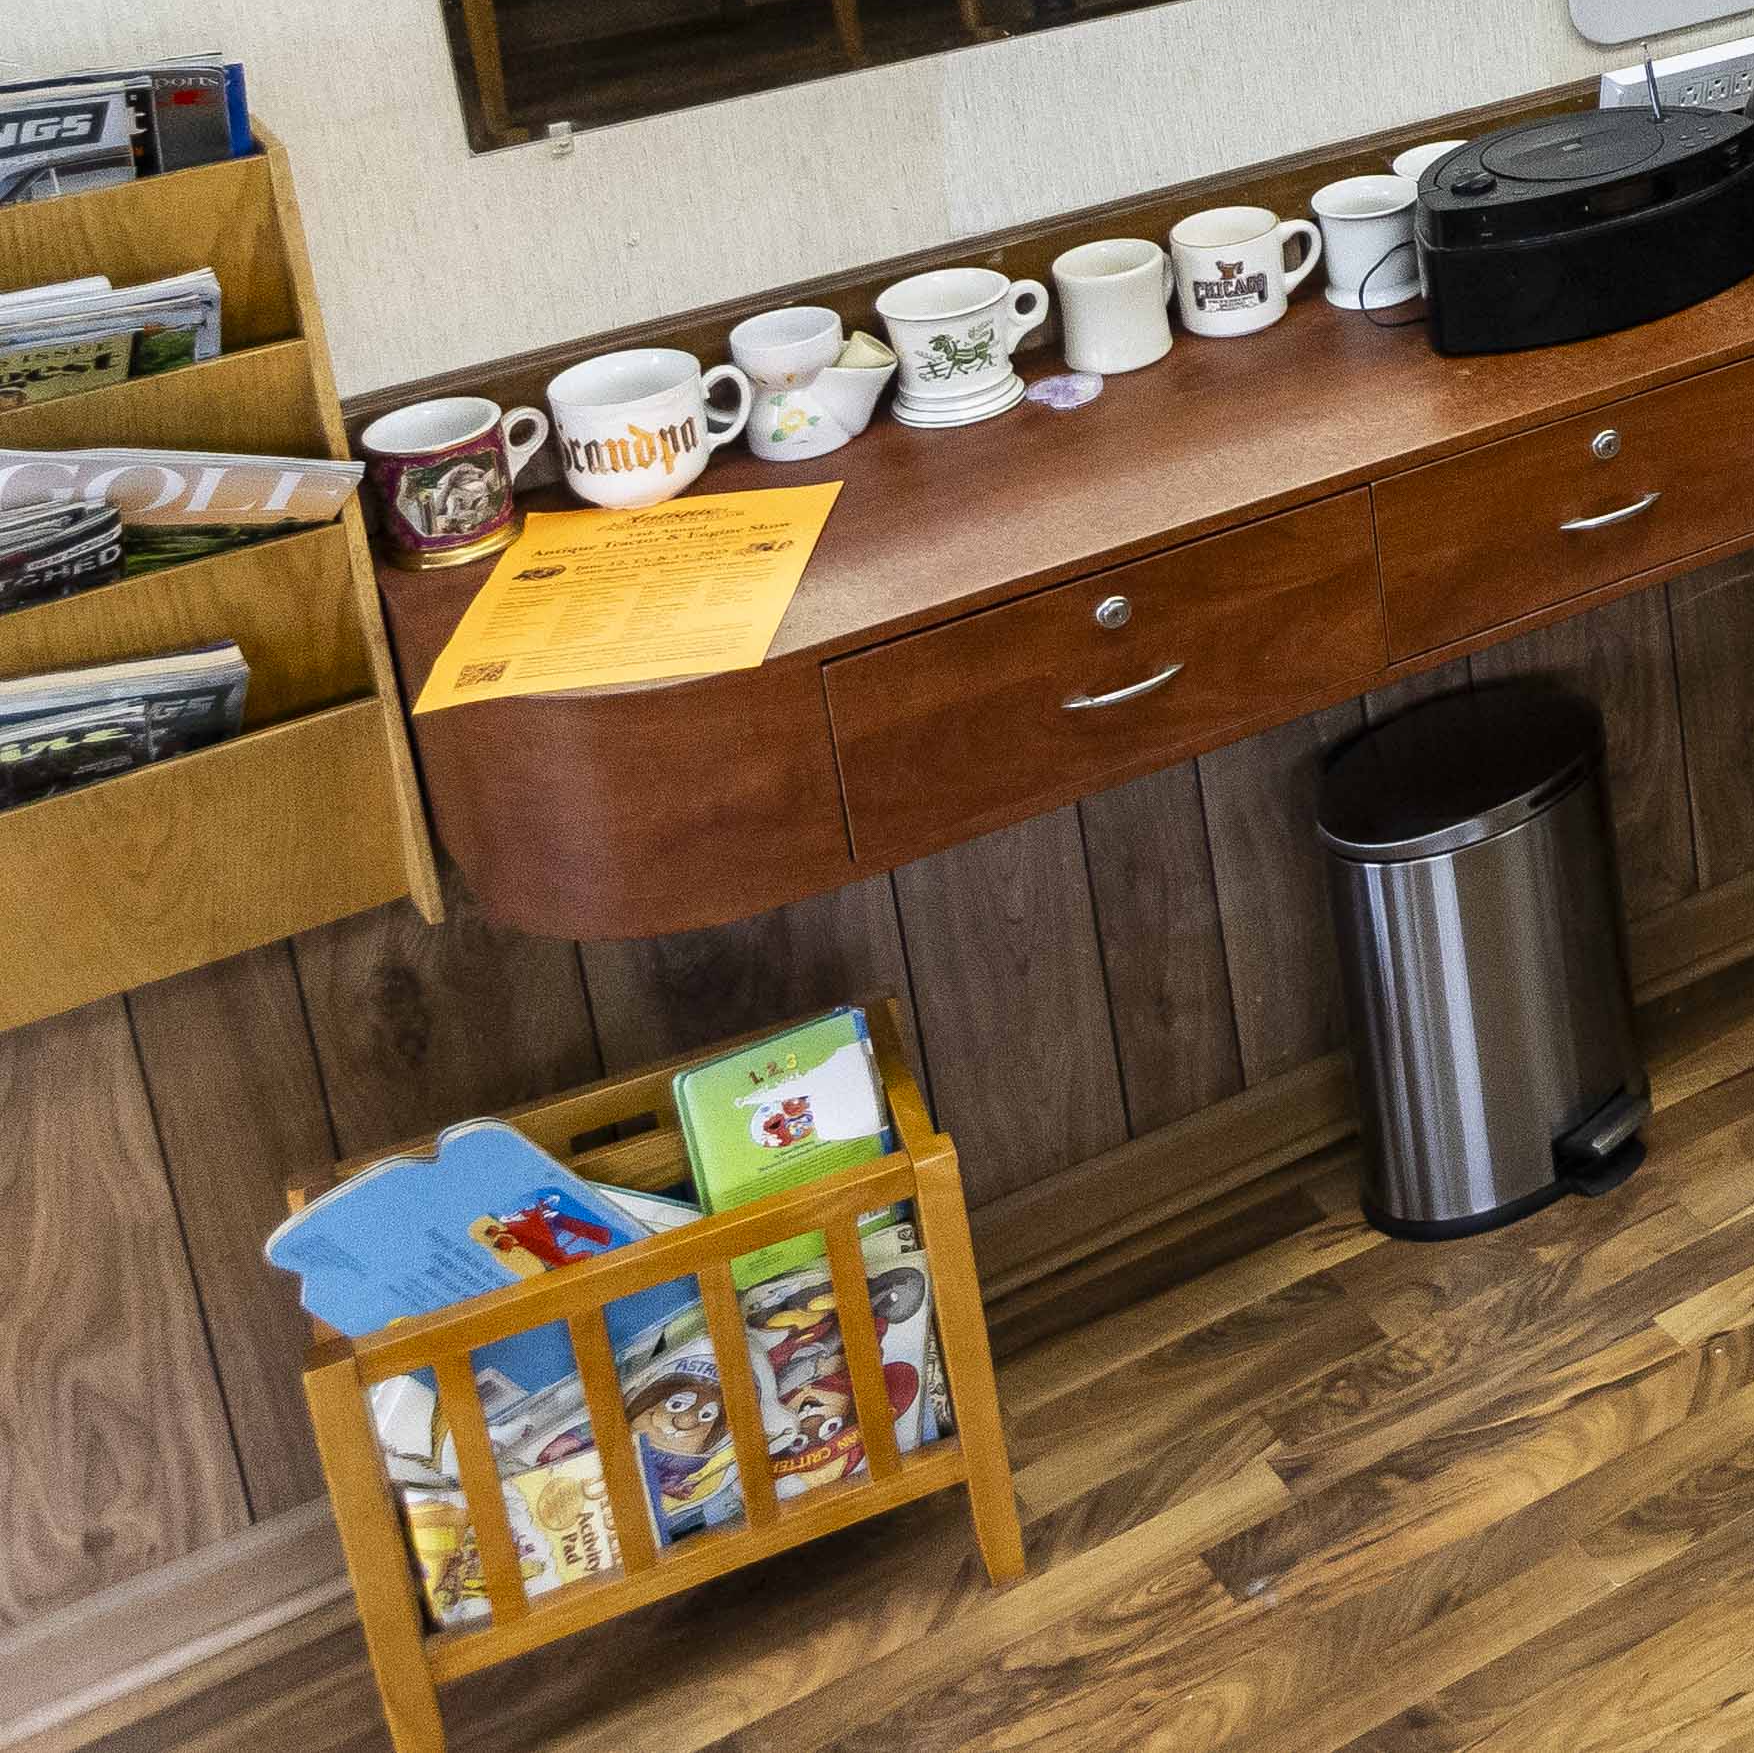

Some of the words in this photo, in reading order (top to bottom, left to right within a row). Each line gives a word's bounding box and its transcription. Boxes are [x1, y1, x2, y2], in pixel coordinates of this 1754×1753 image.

[153, 77, 219, 90] ports
[1193, 273, 1268, 301] CHICAGO
[0, 462, 358, 518] GOLF
[786, 1053, 798, 1069] 3
[561, 1531, 583, 1567] Pad
[577, 1510, 605, 1575] Activity
